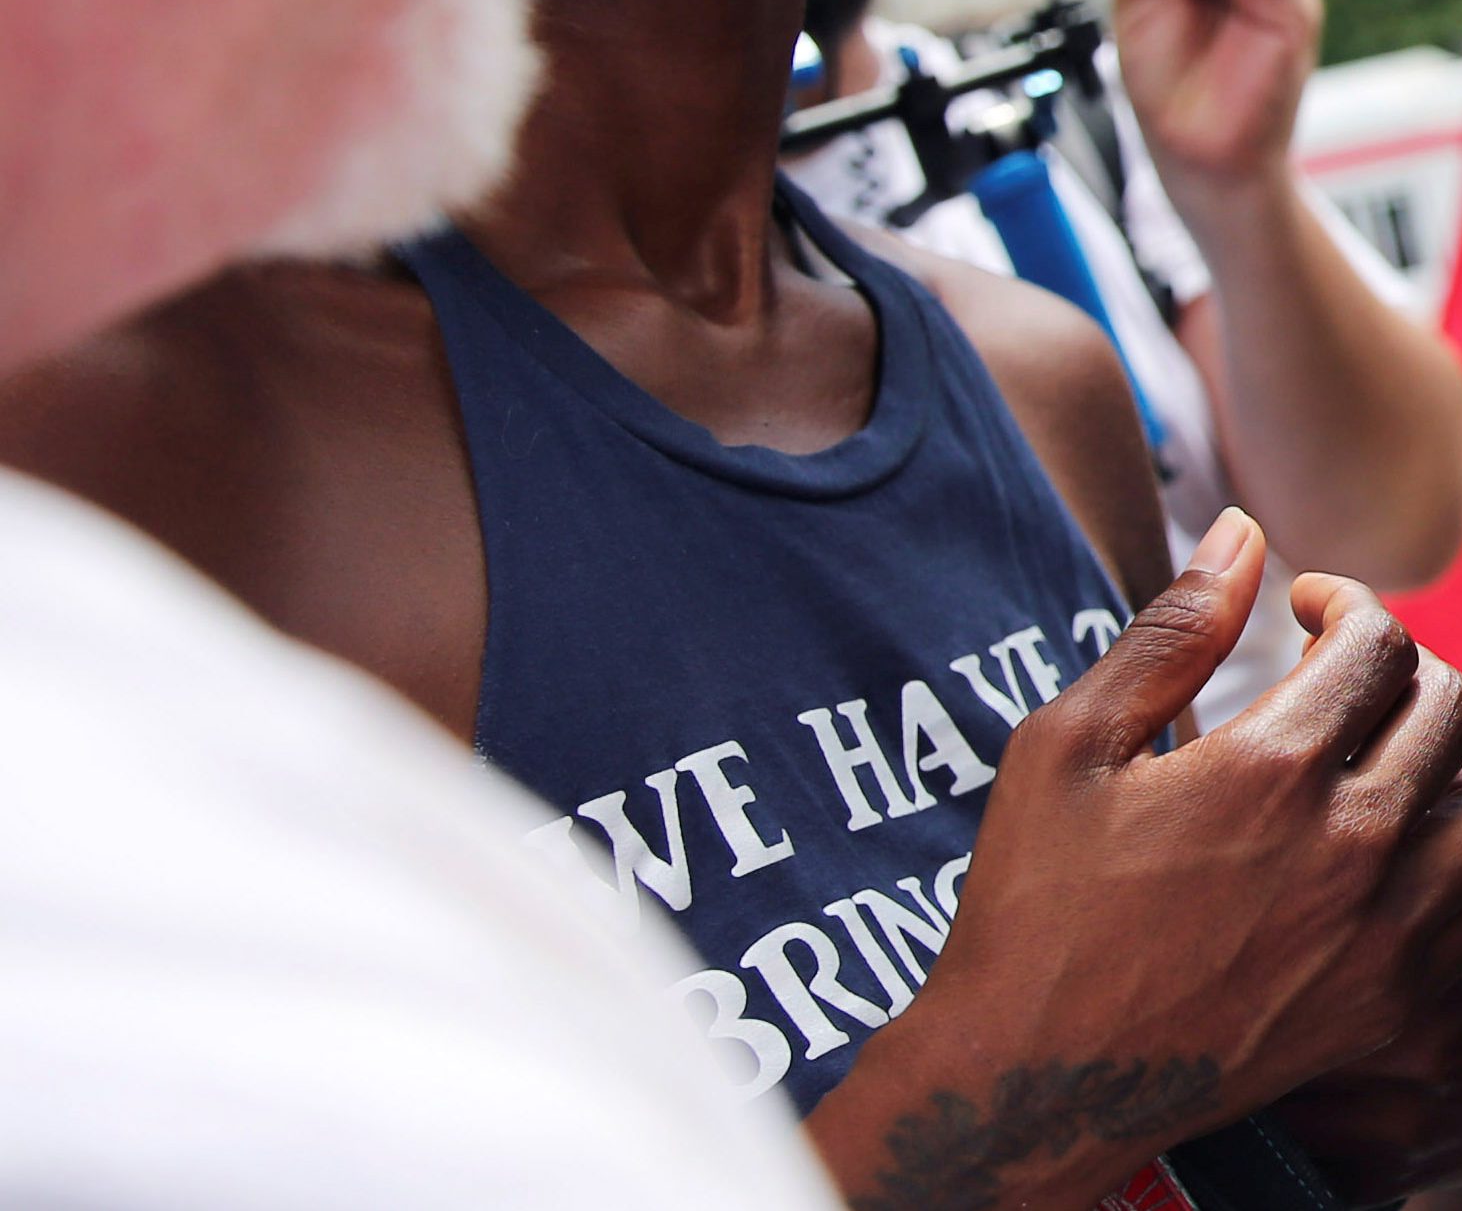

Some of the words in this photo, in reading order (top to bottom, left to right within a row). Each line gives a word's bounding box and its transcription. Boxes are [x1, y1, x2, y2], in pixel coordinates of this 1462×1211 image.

[528, 740, 796, 924] WE
[797, 625, 1061, 831] HAVE
[1072, 608, 1135, 659] T
